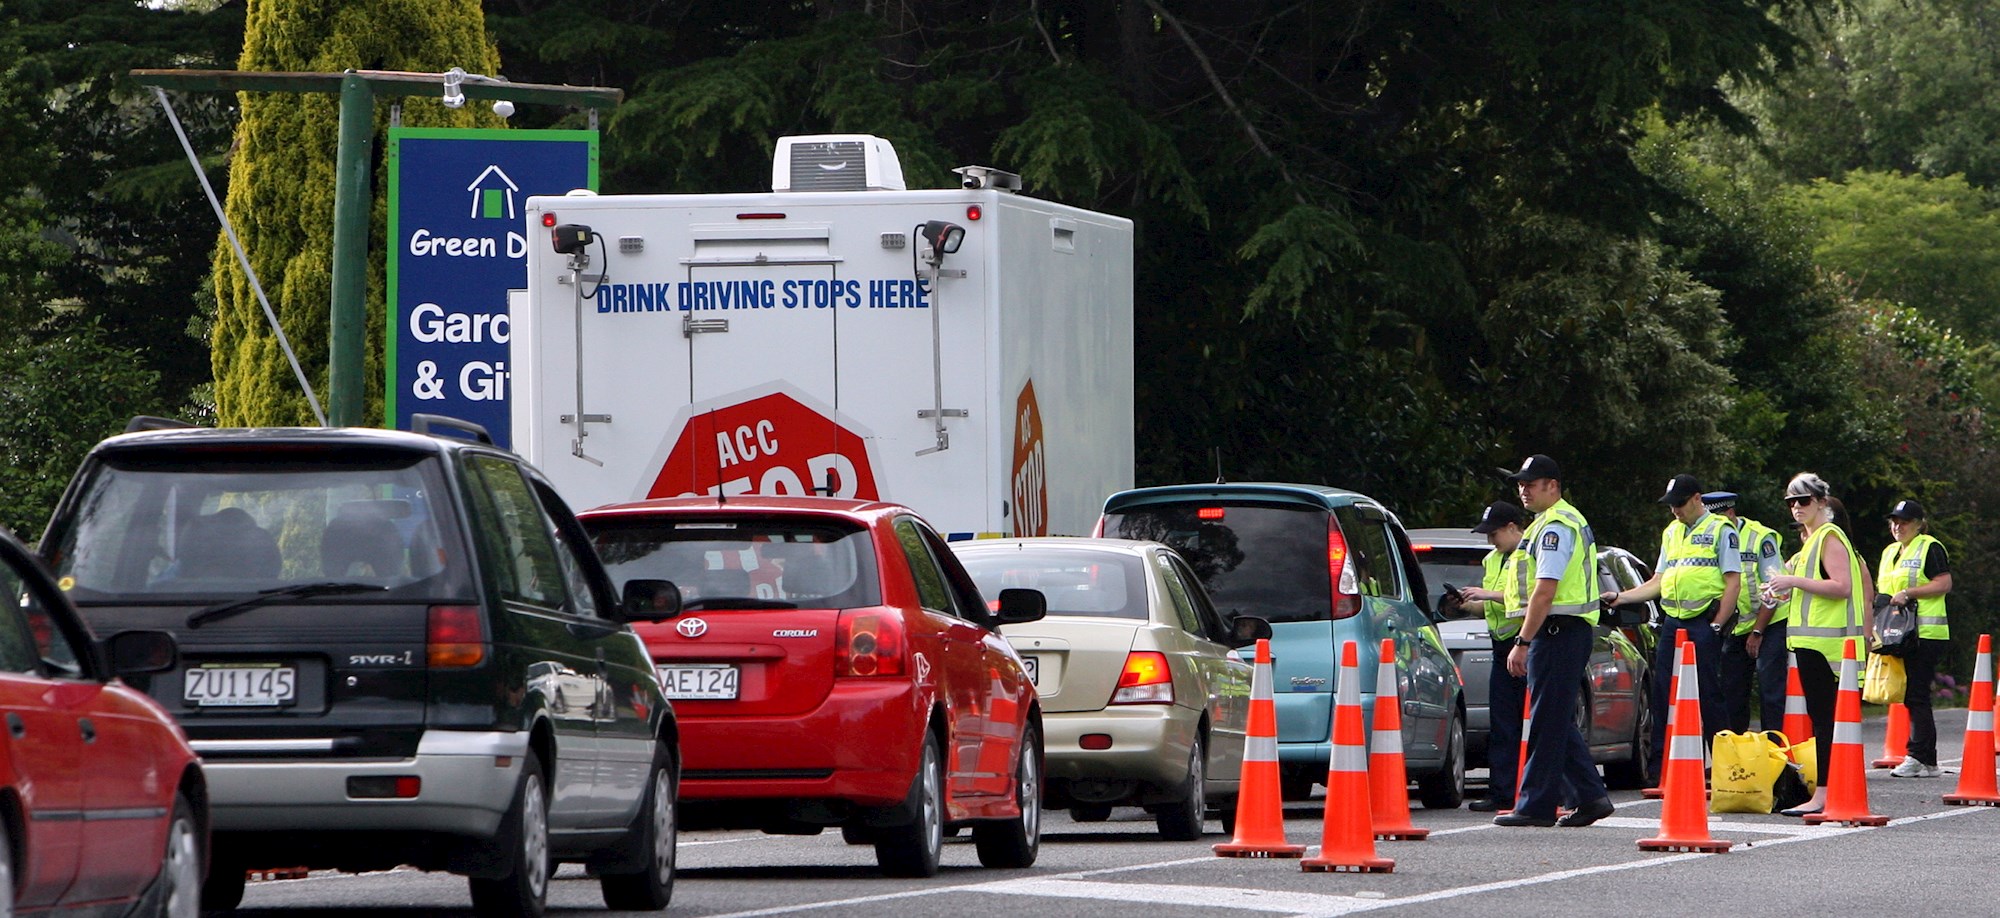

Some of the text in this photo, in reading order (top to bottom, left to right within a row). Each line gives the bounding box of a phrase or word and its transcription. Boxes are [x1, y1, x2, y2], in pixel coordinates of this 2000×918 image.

[410, 229, 496, 257] Green
[597, 279, 929, 314] DRINK DRIVING STOPS HERE
[412, 360, 510, 401] & Gi
[716, 419, 779, 468] ACC
[1015, 440, 1043, 537] STOP
[1740, 553, 1757, 561] OLICE
[773, 629, 817, 637] COROLLA
[187, 671, 291, 698] ZU1145
